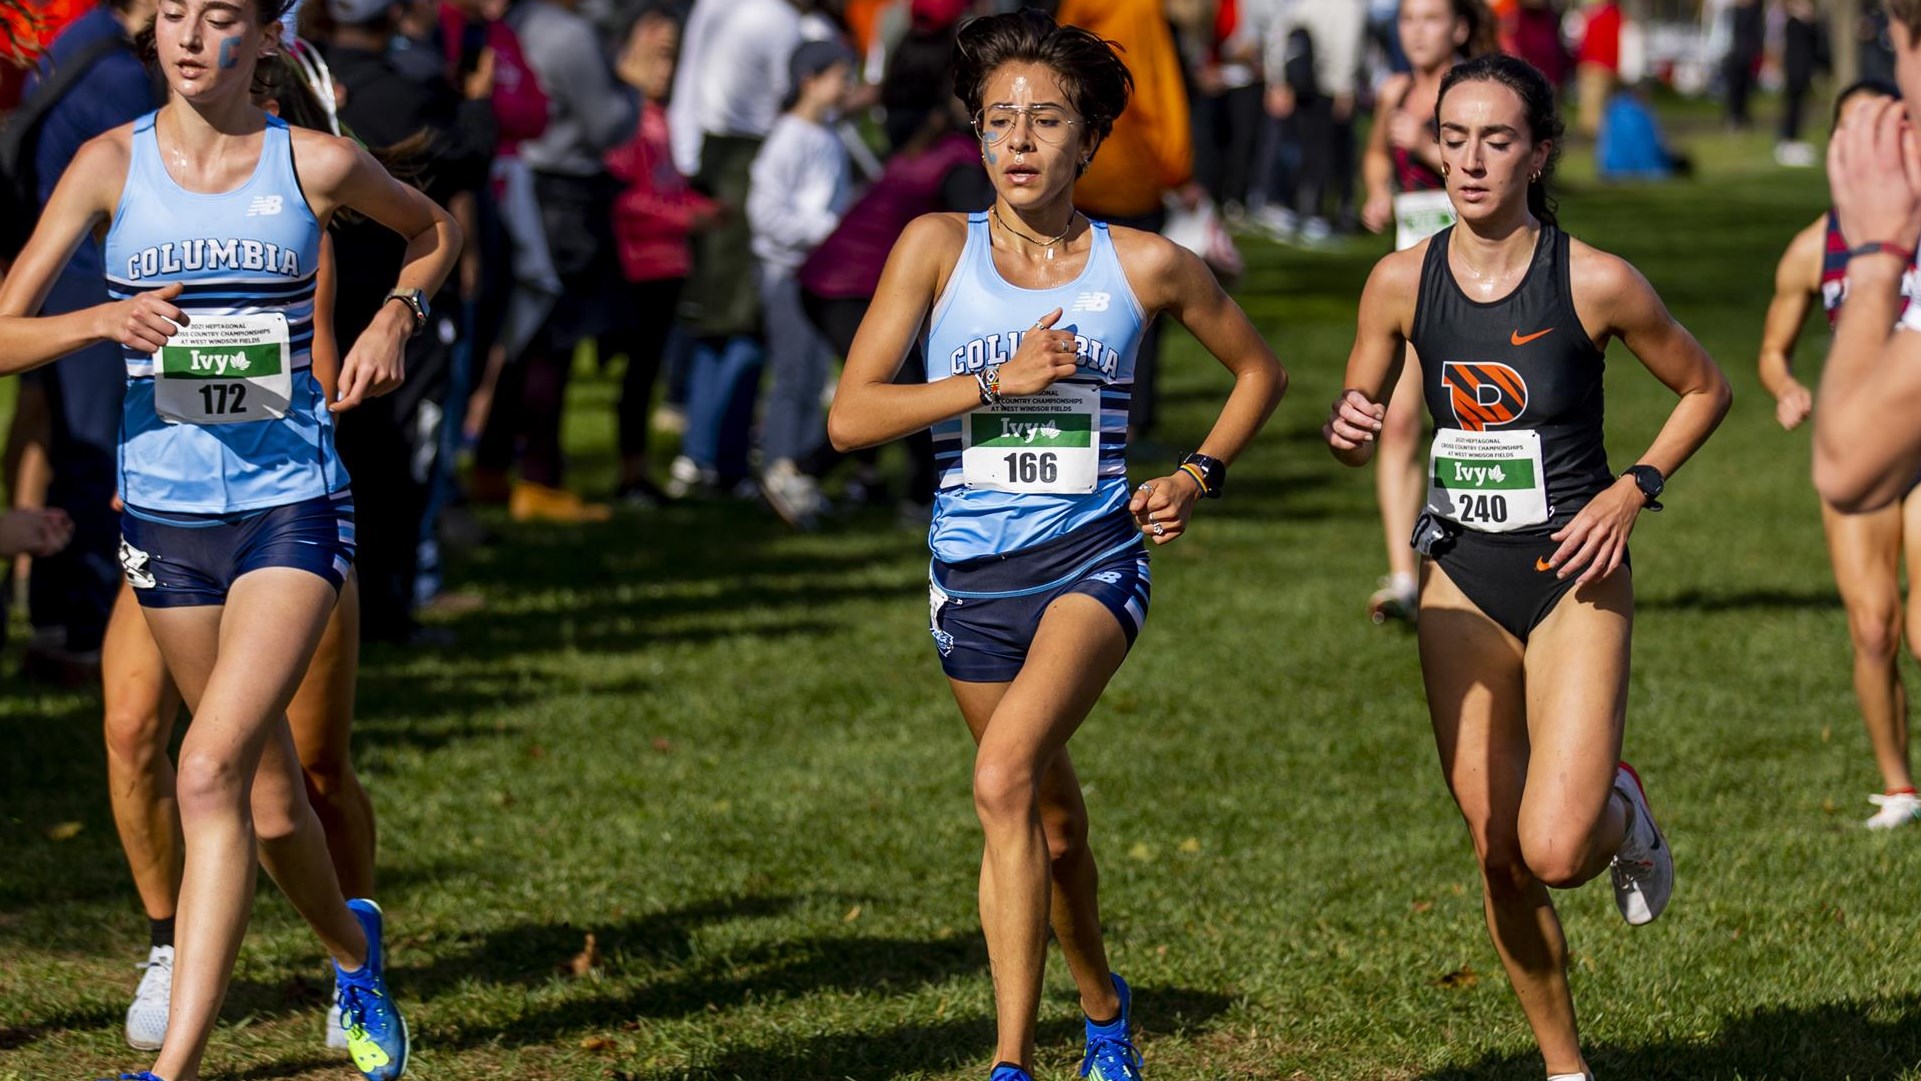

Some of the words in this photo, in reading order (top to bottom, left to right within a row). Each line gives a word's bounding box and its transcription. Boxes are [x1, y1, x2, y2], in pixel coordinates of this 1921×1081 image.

[127, 238, 300, 280] COLUMBIA
[220, 329, 271, 337] CHAMPIONSHIPS
[190, 349, 229, 375] Ivy
[199, 383, 247, 414] 172
[1442, 361, 1529, 431] P
[1001, 417, 1039, 443] Ivy
[1003, 452, 1058, 483] 166
[1454, 461, 1487, 487] Ivy
[1459, 494, 1508, 522] 240
